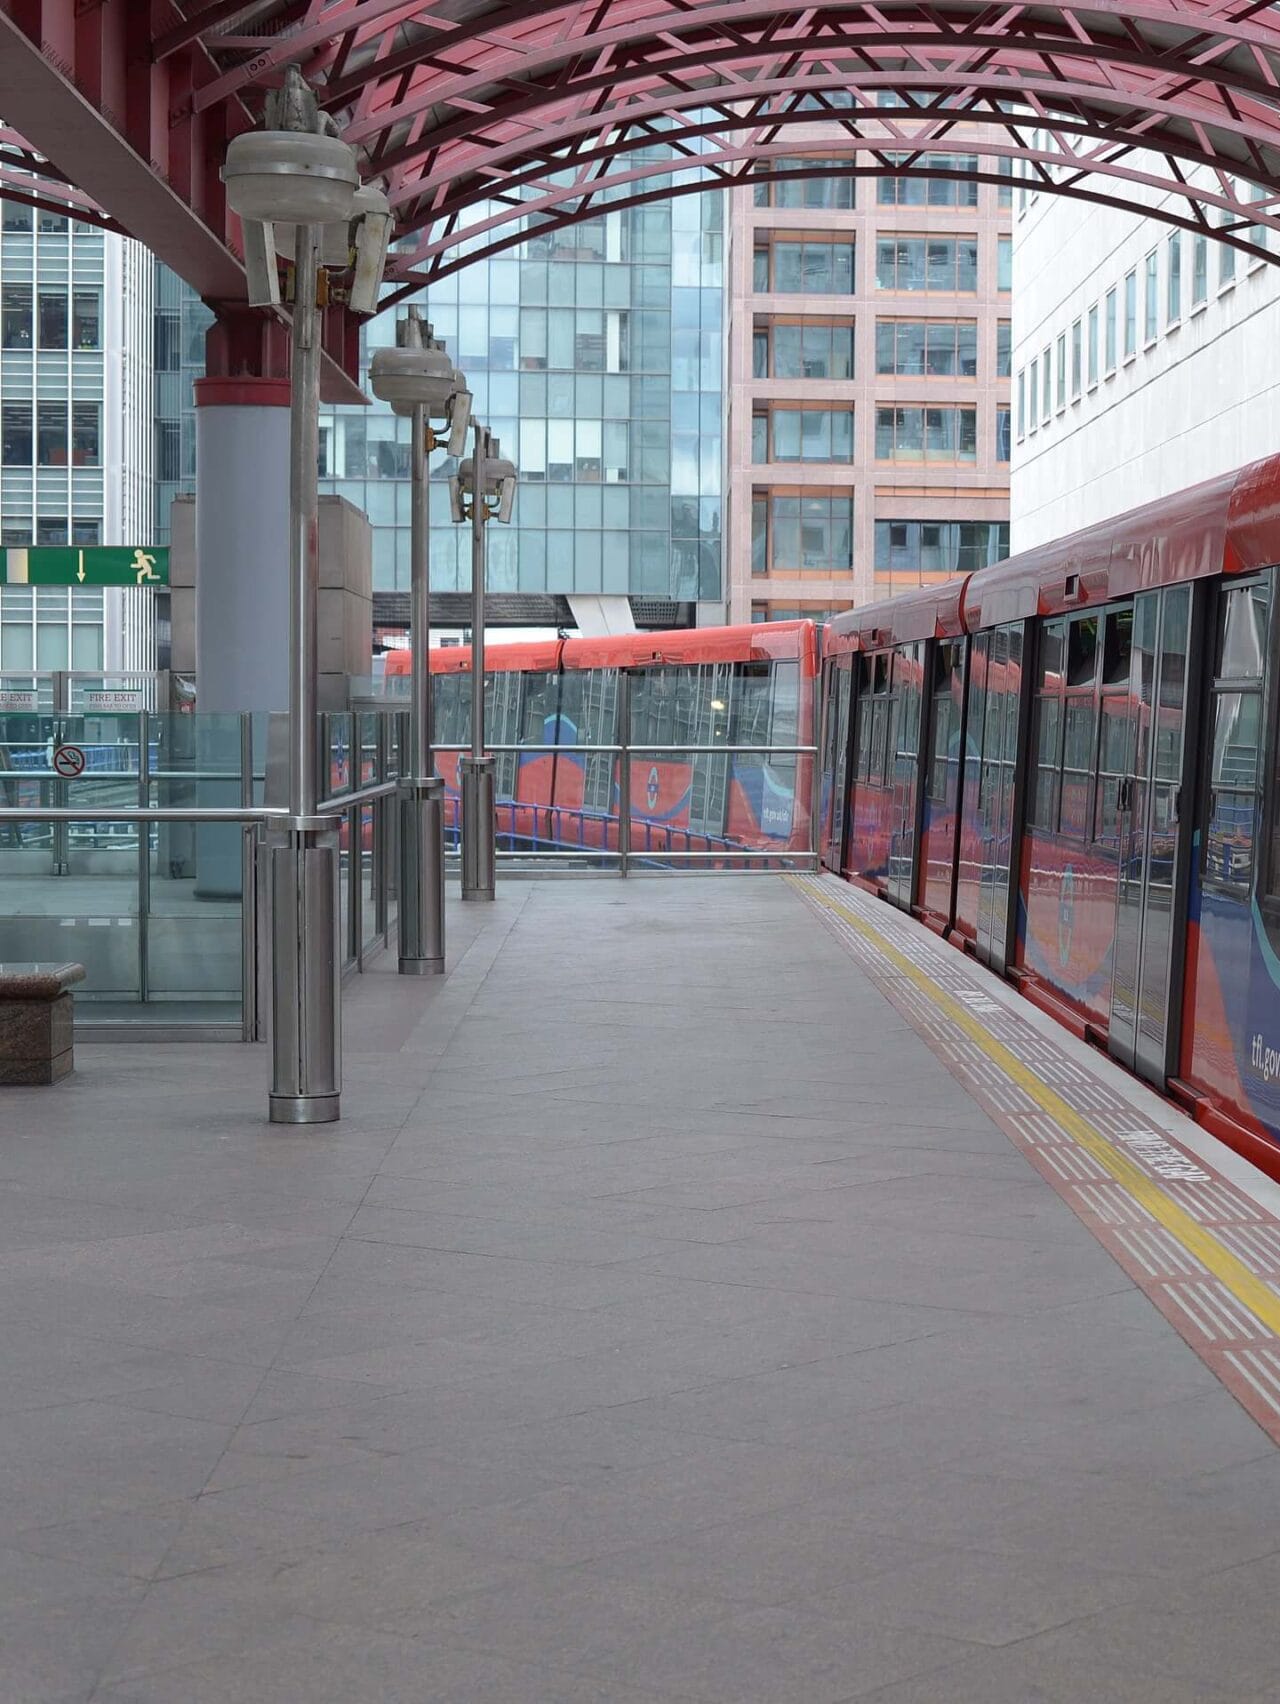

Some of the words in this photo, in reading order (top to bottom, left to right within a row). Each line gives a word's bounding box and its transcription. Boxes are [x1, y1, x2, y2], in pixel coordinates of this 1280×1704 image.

[9, 693, 33, 702] EXIT
[89, 693, 112, 702] FIRE
[113, 693, 137, 702] EXIT
[1147, 1161, 1212, 1182] GAP
